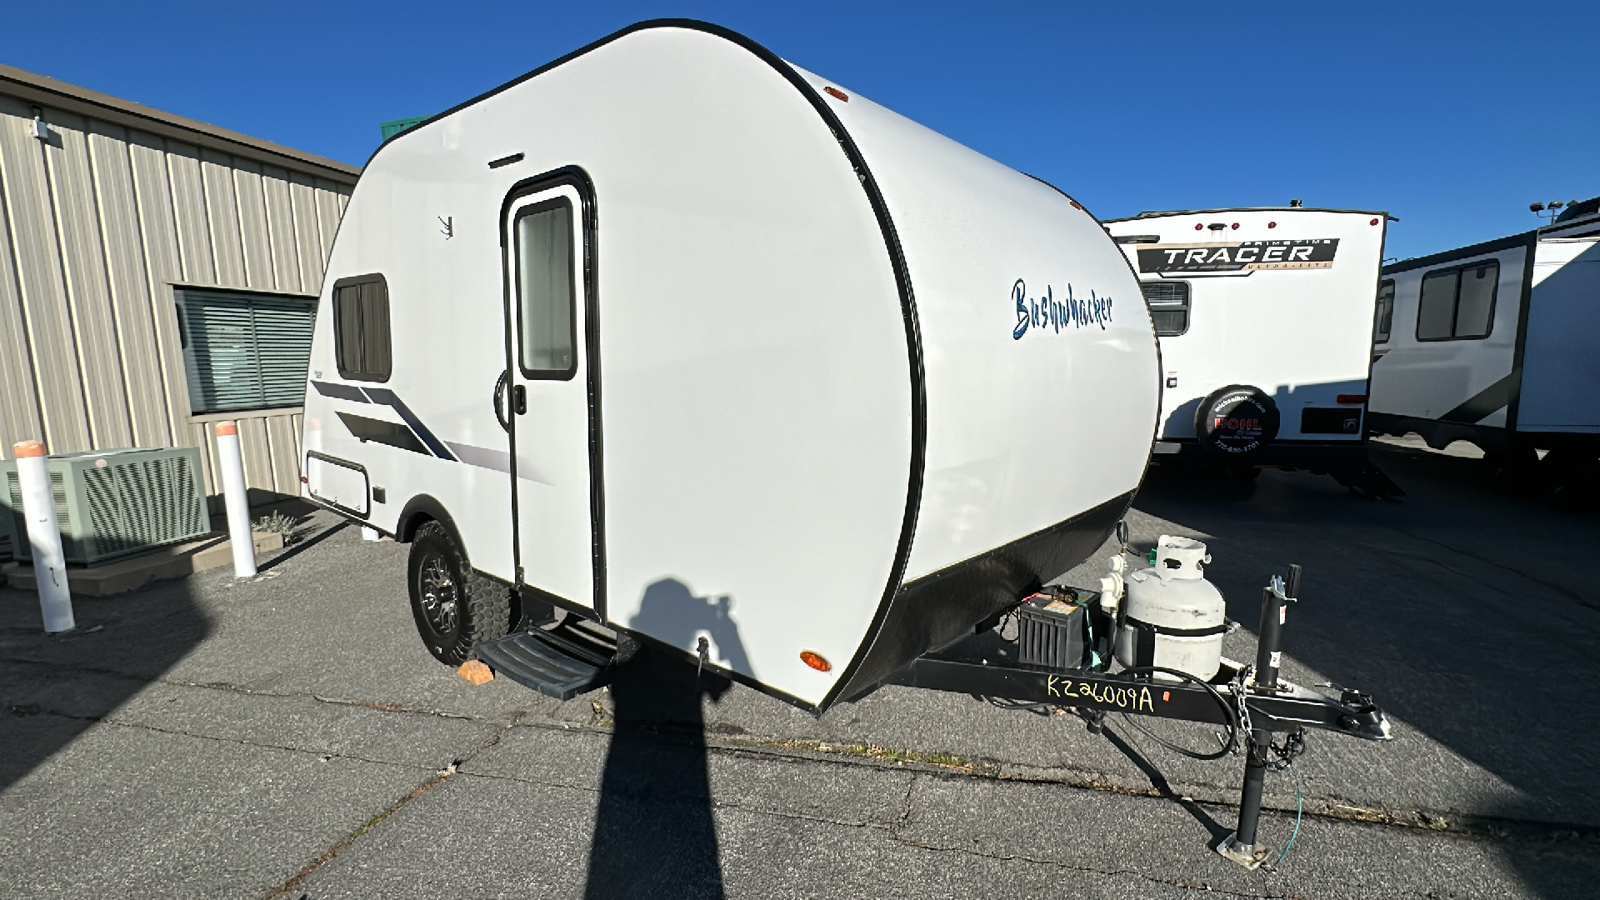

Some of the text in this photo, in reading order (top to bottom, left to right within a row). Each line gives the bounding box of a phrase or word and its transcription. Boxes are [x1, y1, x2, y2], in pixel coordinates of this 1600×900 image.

[1163, 246, 1314, 265] TRACER
[1011, 278, 1113, 340] Bushwhacker
[1214, 418, 1263, 430] HOHL
